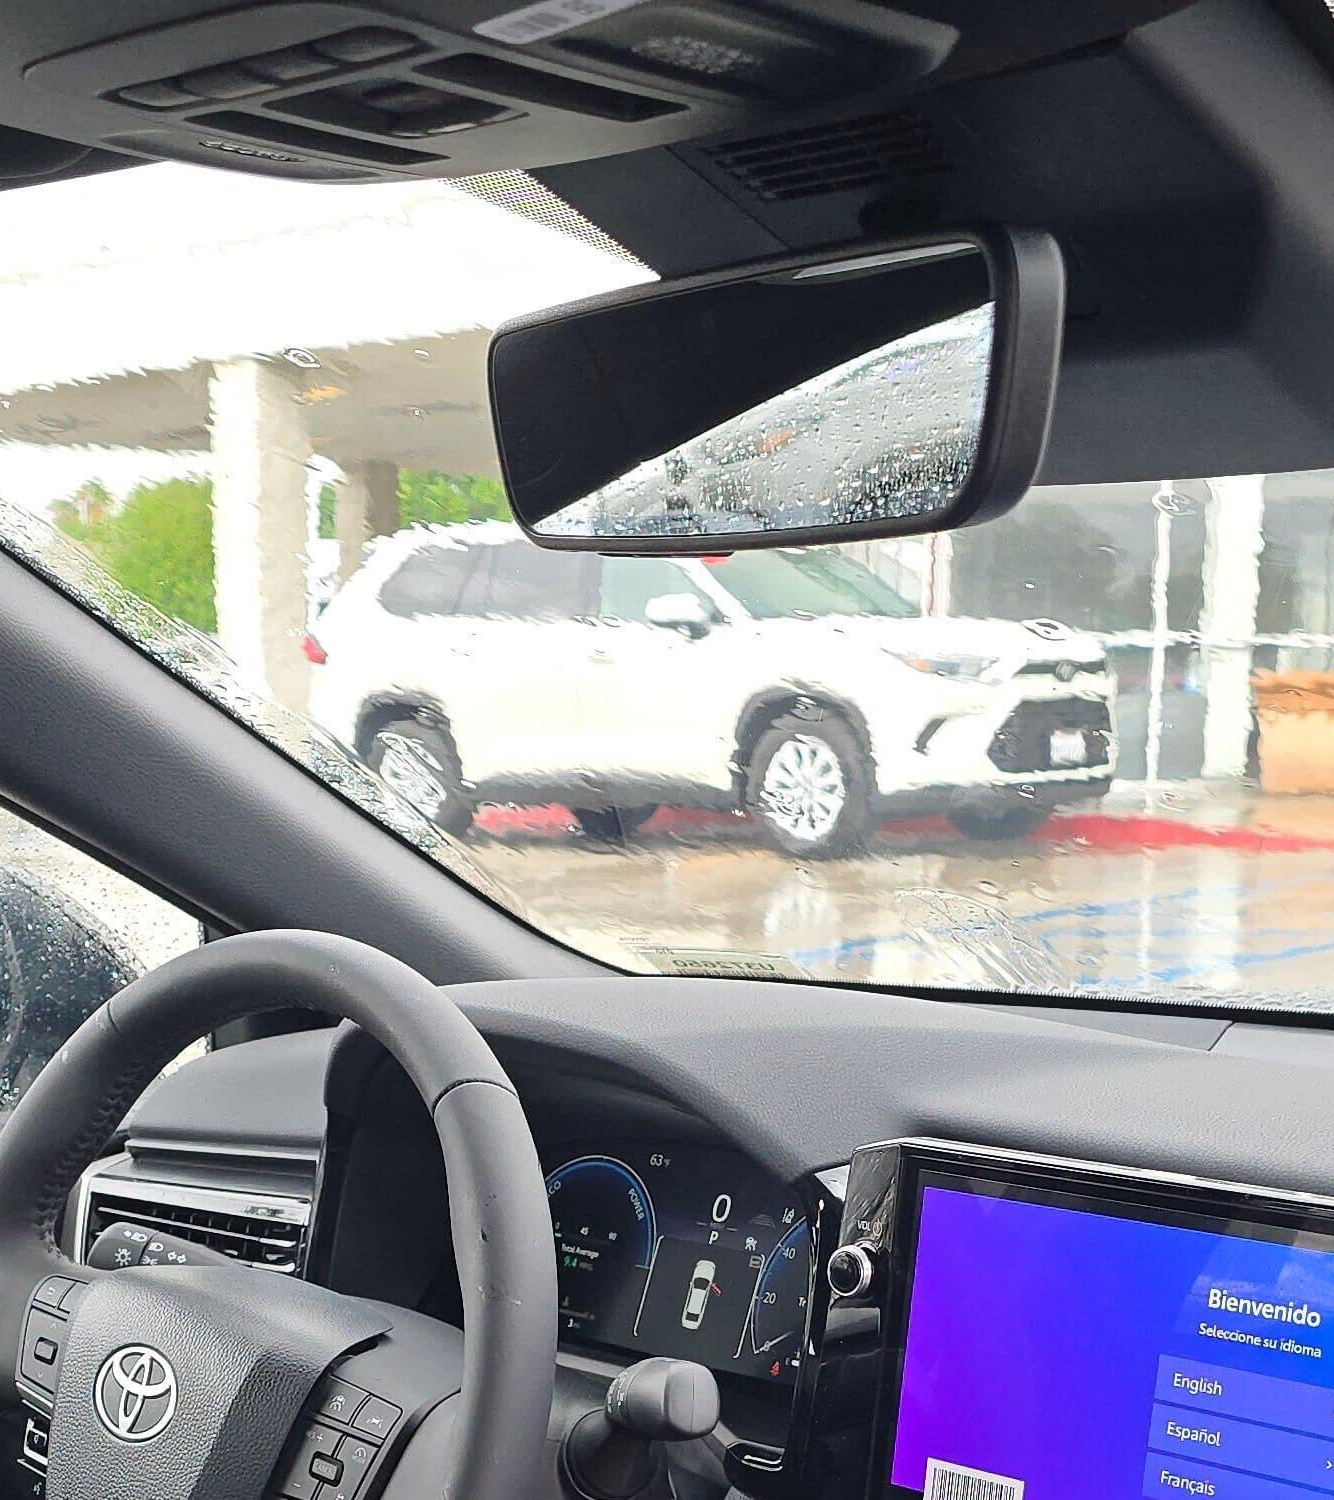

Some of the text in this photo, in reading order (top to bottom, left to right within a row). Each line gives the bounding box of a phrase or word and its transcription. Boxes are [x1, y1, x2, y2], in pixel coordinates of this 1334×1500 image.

[627, 1188, 645, 1221] POWER
[712, 1194, 732, 1222] 0
[708, 1230, 719, 1245] P
[782, 1247, 796, 1260] 40
[763, 1293, 776, 1304] 20
[1208, 1288, 1321, 1327] Bienvenido
[1198, 1323, 1322, 1358] Seleccione su idioma
[1173, 1373, 1222, 1396] English
[1167, 1422, 1221, 1446] Español
[1160, 1470, 1215, 1496] Français
